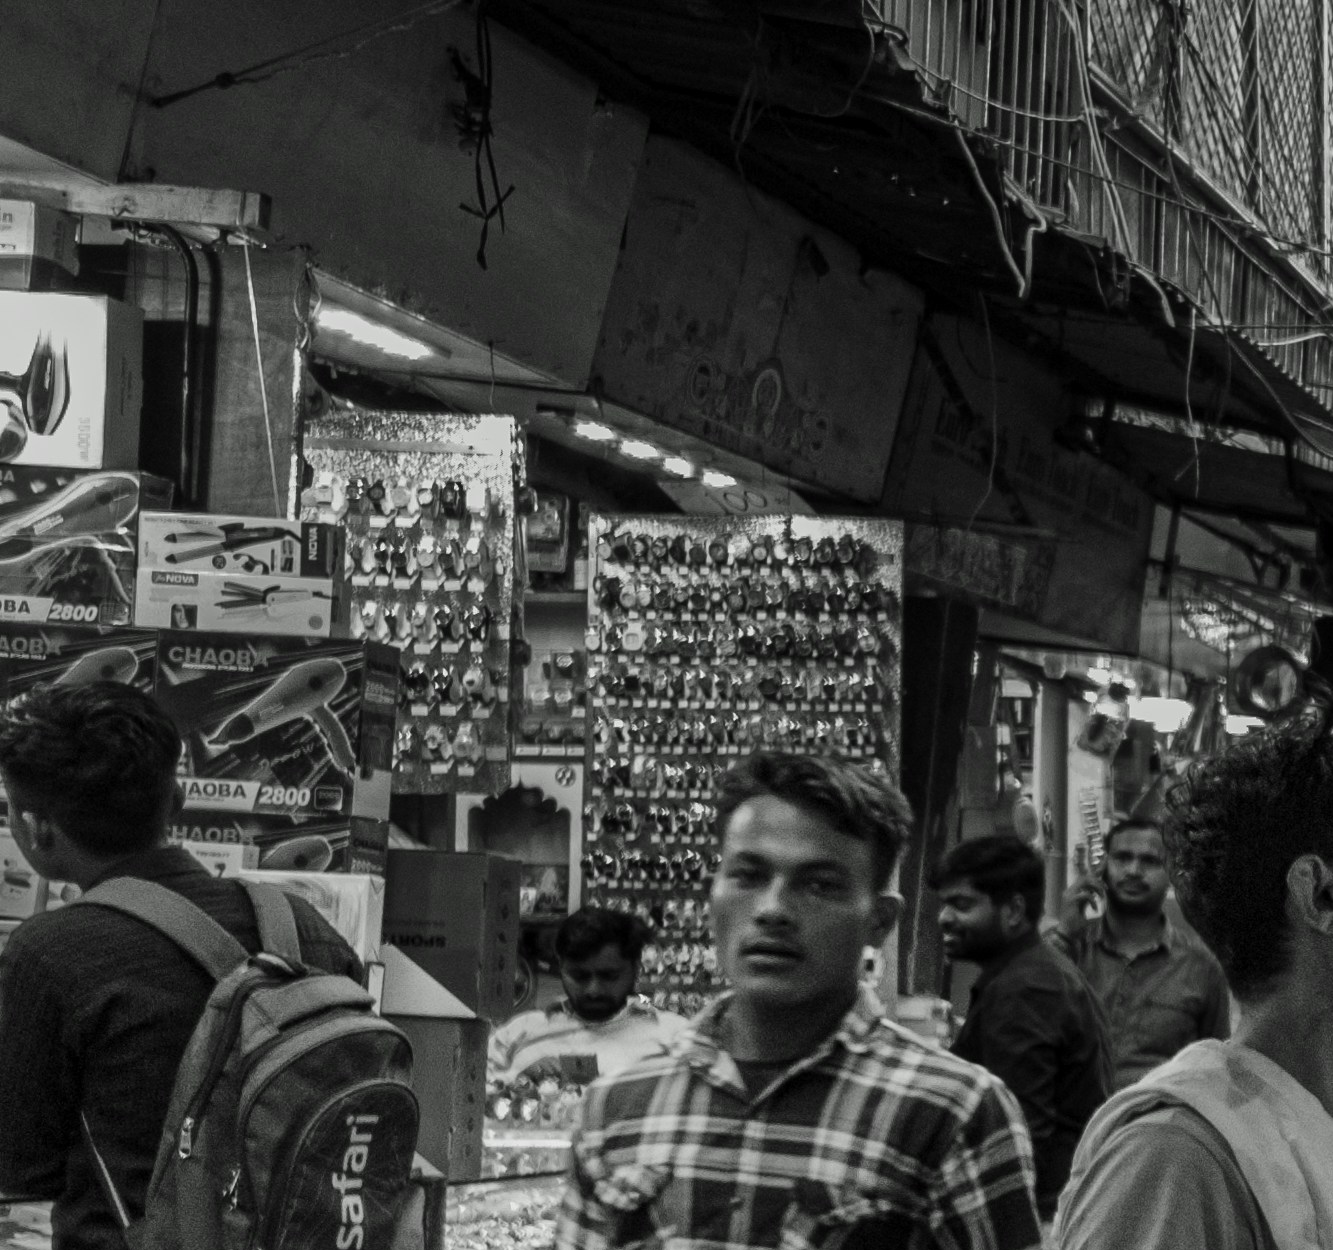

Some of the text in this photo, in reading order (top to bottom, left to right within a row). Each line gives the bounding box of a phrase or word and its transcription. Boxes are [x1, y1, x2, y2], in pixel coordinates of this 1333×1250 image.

[308, 526, 318, 561] NOVA
[166, 575, 196, 585] NOVA
[49, 604, 98, 622] 2800
[258, 785, 312, 807] 2800
